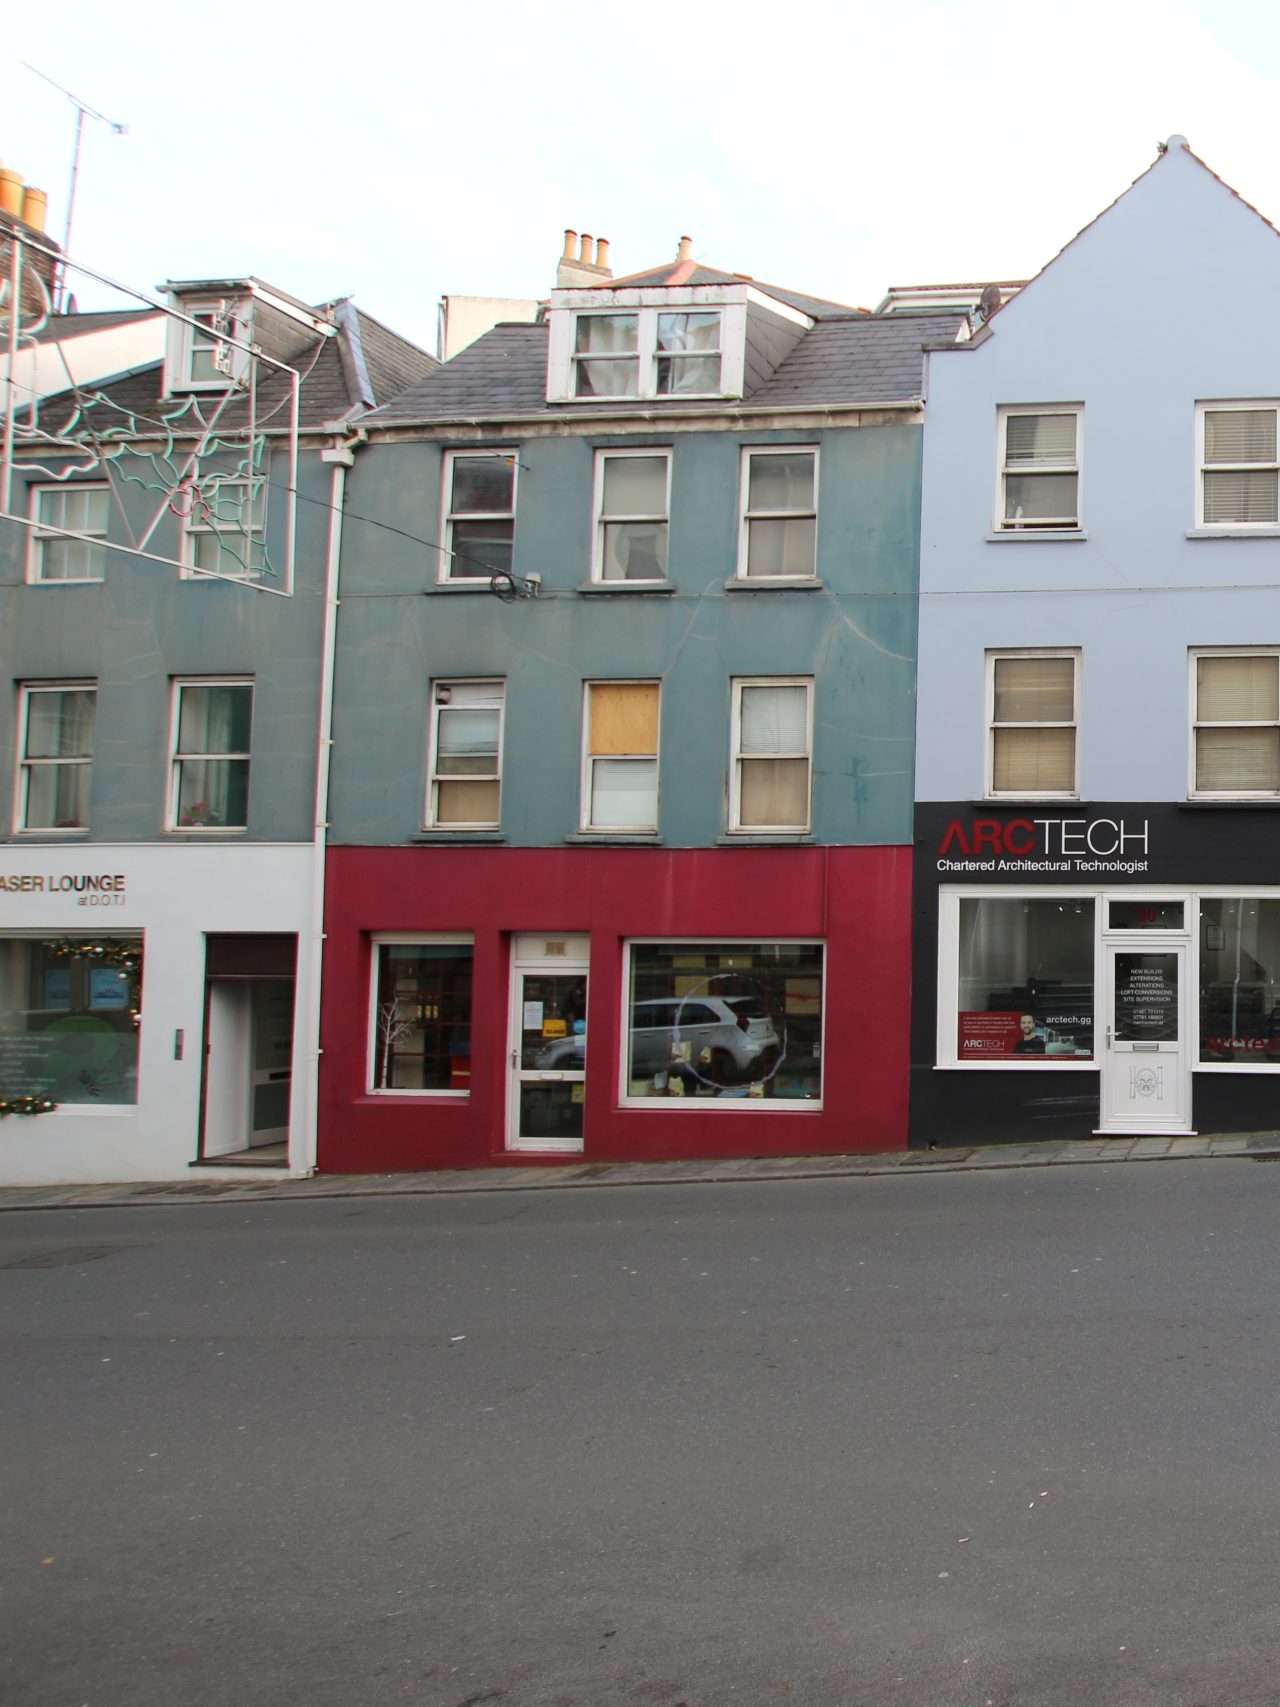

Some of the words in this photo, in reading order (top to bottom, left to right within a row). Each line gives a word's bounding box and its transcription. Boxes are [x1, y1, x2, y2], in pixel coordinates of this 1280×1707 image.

[937, 859, 995, 871] Chartered
[998, 859, 1071, 871] Architectural
[1074, 859, 1149, 873] Technologist
[49, 875, 126, 892] LOUNGE
[78, 895, 88, 906] at
[1046, 1016, 1092, 1024] arctech.gg
